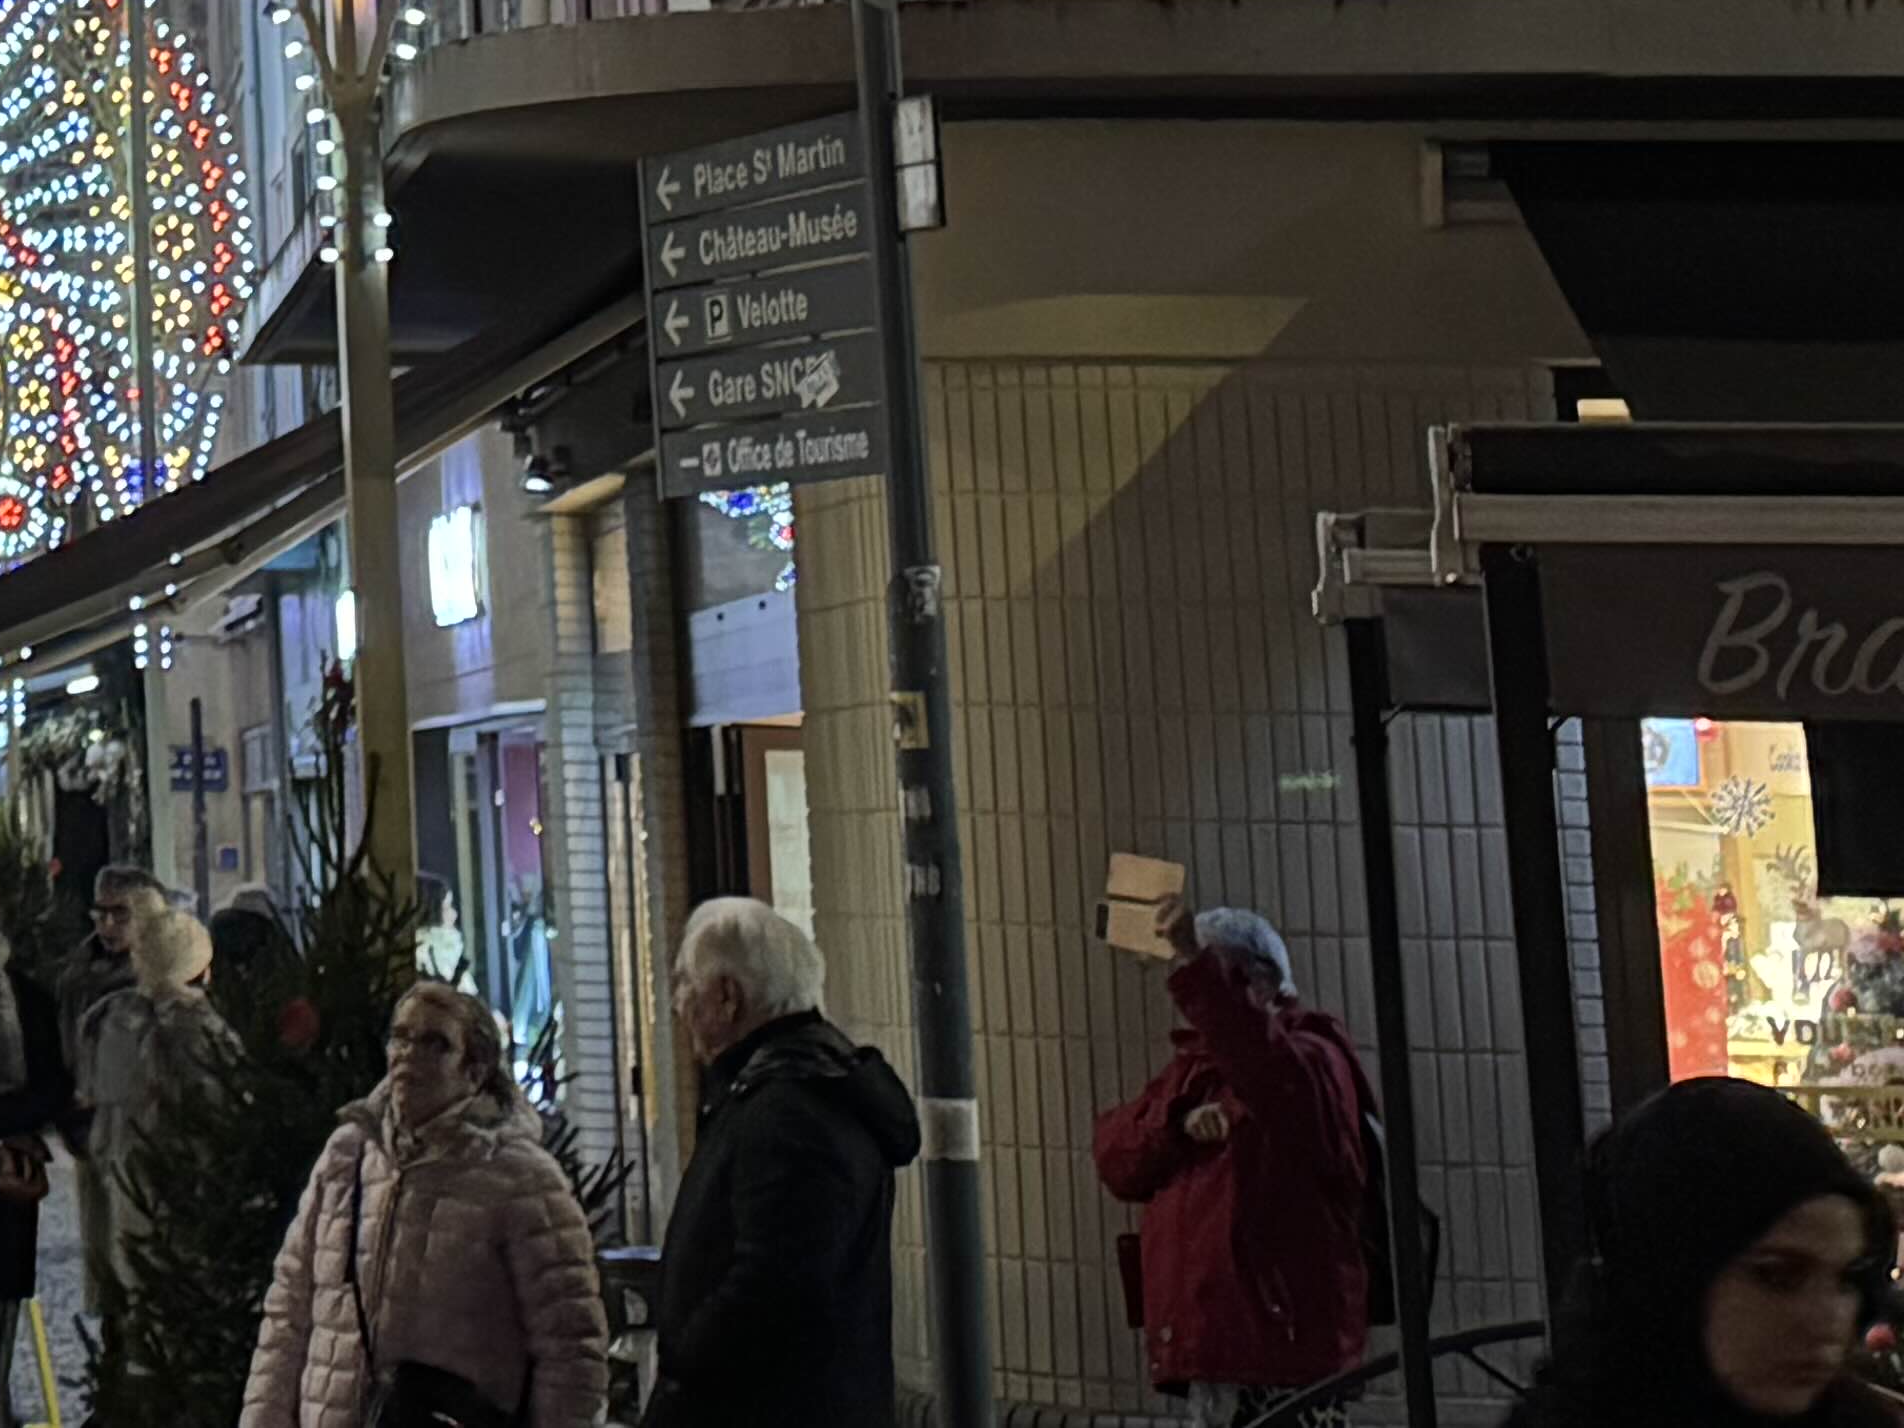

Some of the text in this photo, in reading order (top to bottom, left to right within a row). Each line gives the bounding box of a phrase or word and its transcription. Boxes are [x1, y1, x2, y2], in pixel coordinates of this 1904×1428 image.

[693, 158, 748, 198] Place
[777, 133, 846, 178] Martin
[698, 203, 858, 265] Château-Musée
[737, 290, 808, 329] Velotte
[708, 369, 755, 407] Gare
[727, 424, 869, 472] Office de Tourisme
